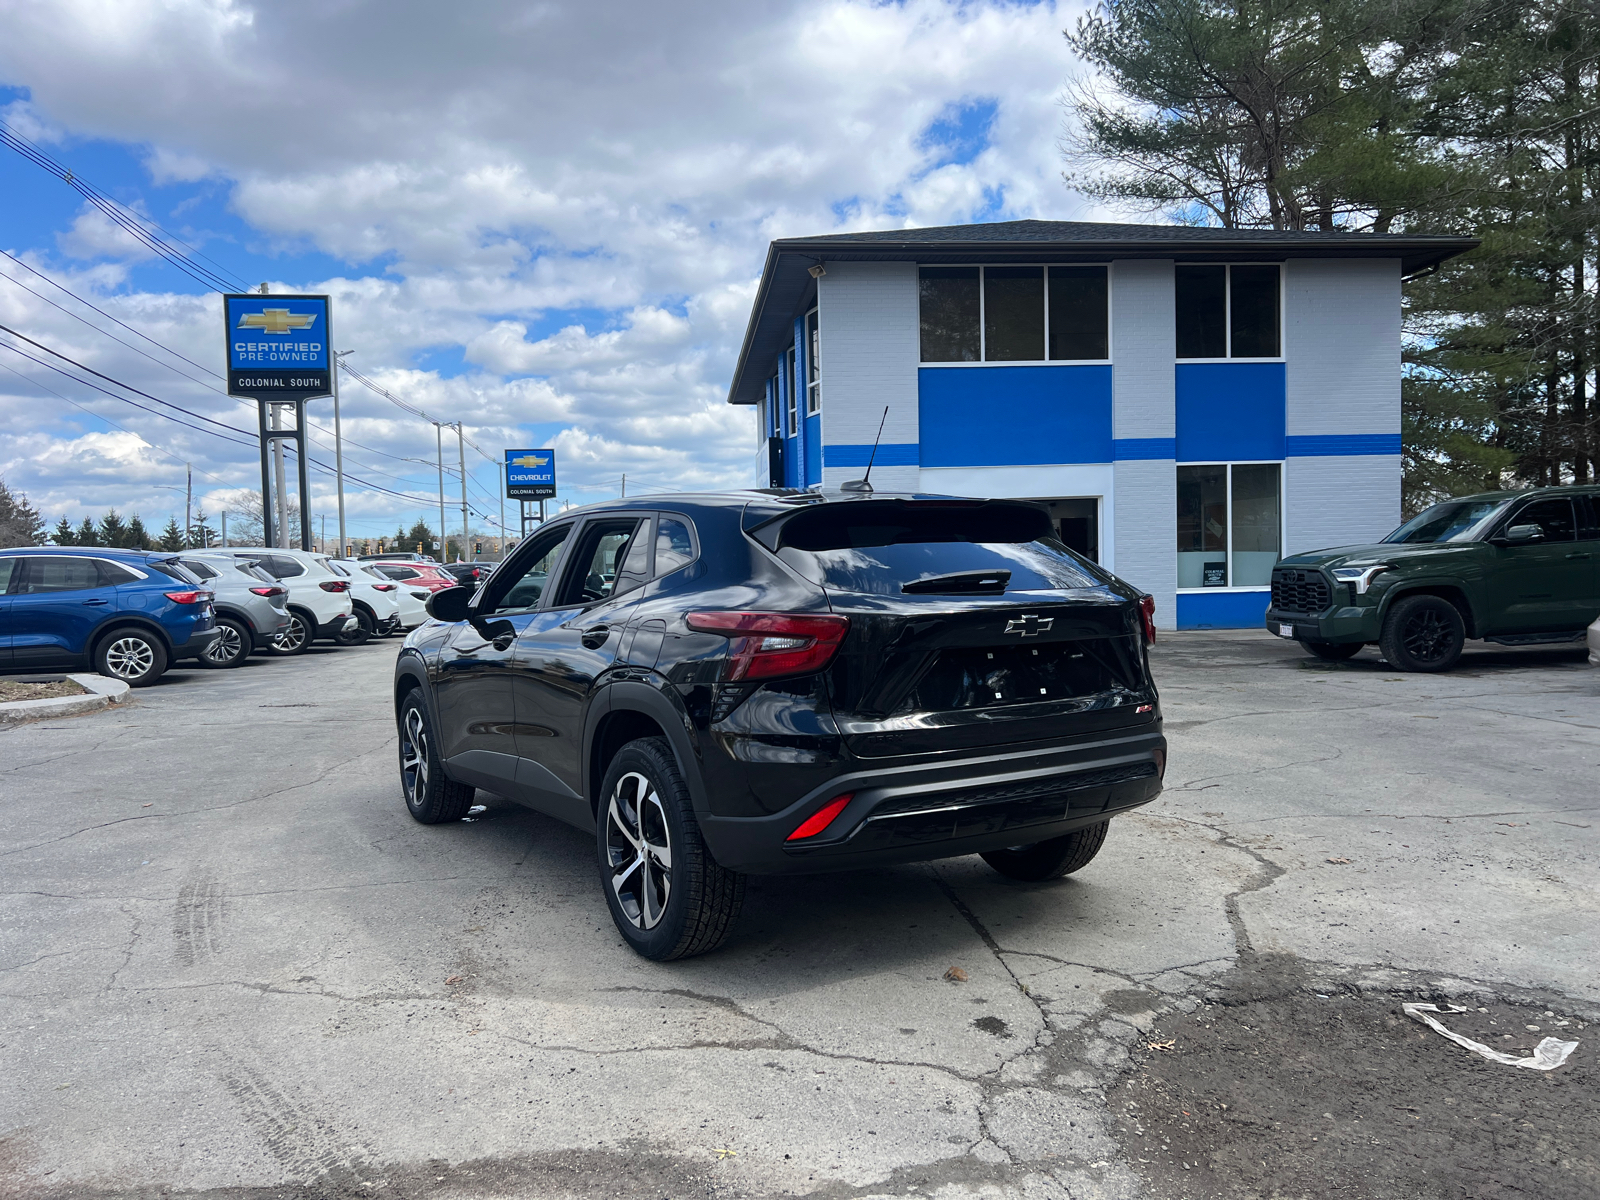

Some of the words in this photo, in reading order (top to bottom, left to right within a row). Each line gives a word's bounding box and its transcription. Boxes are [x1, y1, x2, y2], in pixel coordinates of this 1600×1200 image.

[235, 342, 322, 352] CERTIFIED
[240, 352, 318, 361] PRE-OWNED
[238, 378, 285, 387] COLONIAL
[290, 378, 321, 387] SOUTH
